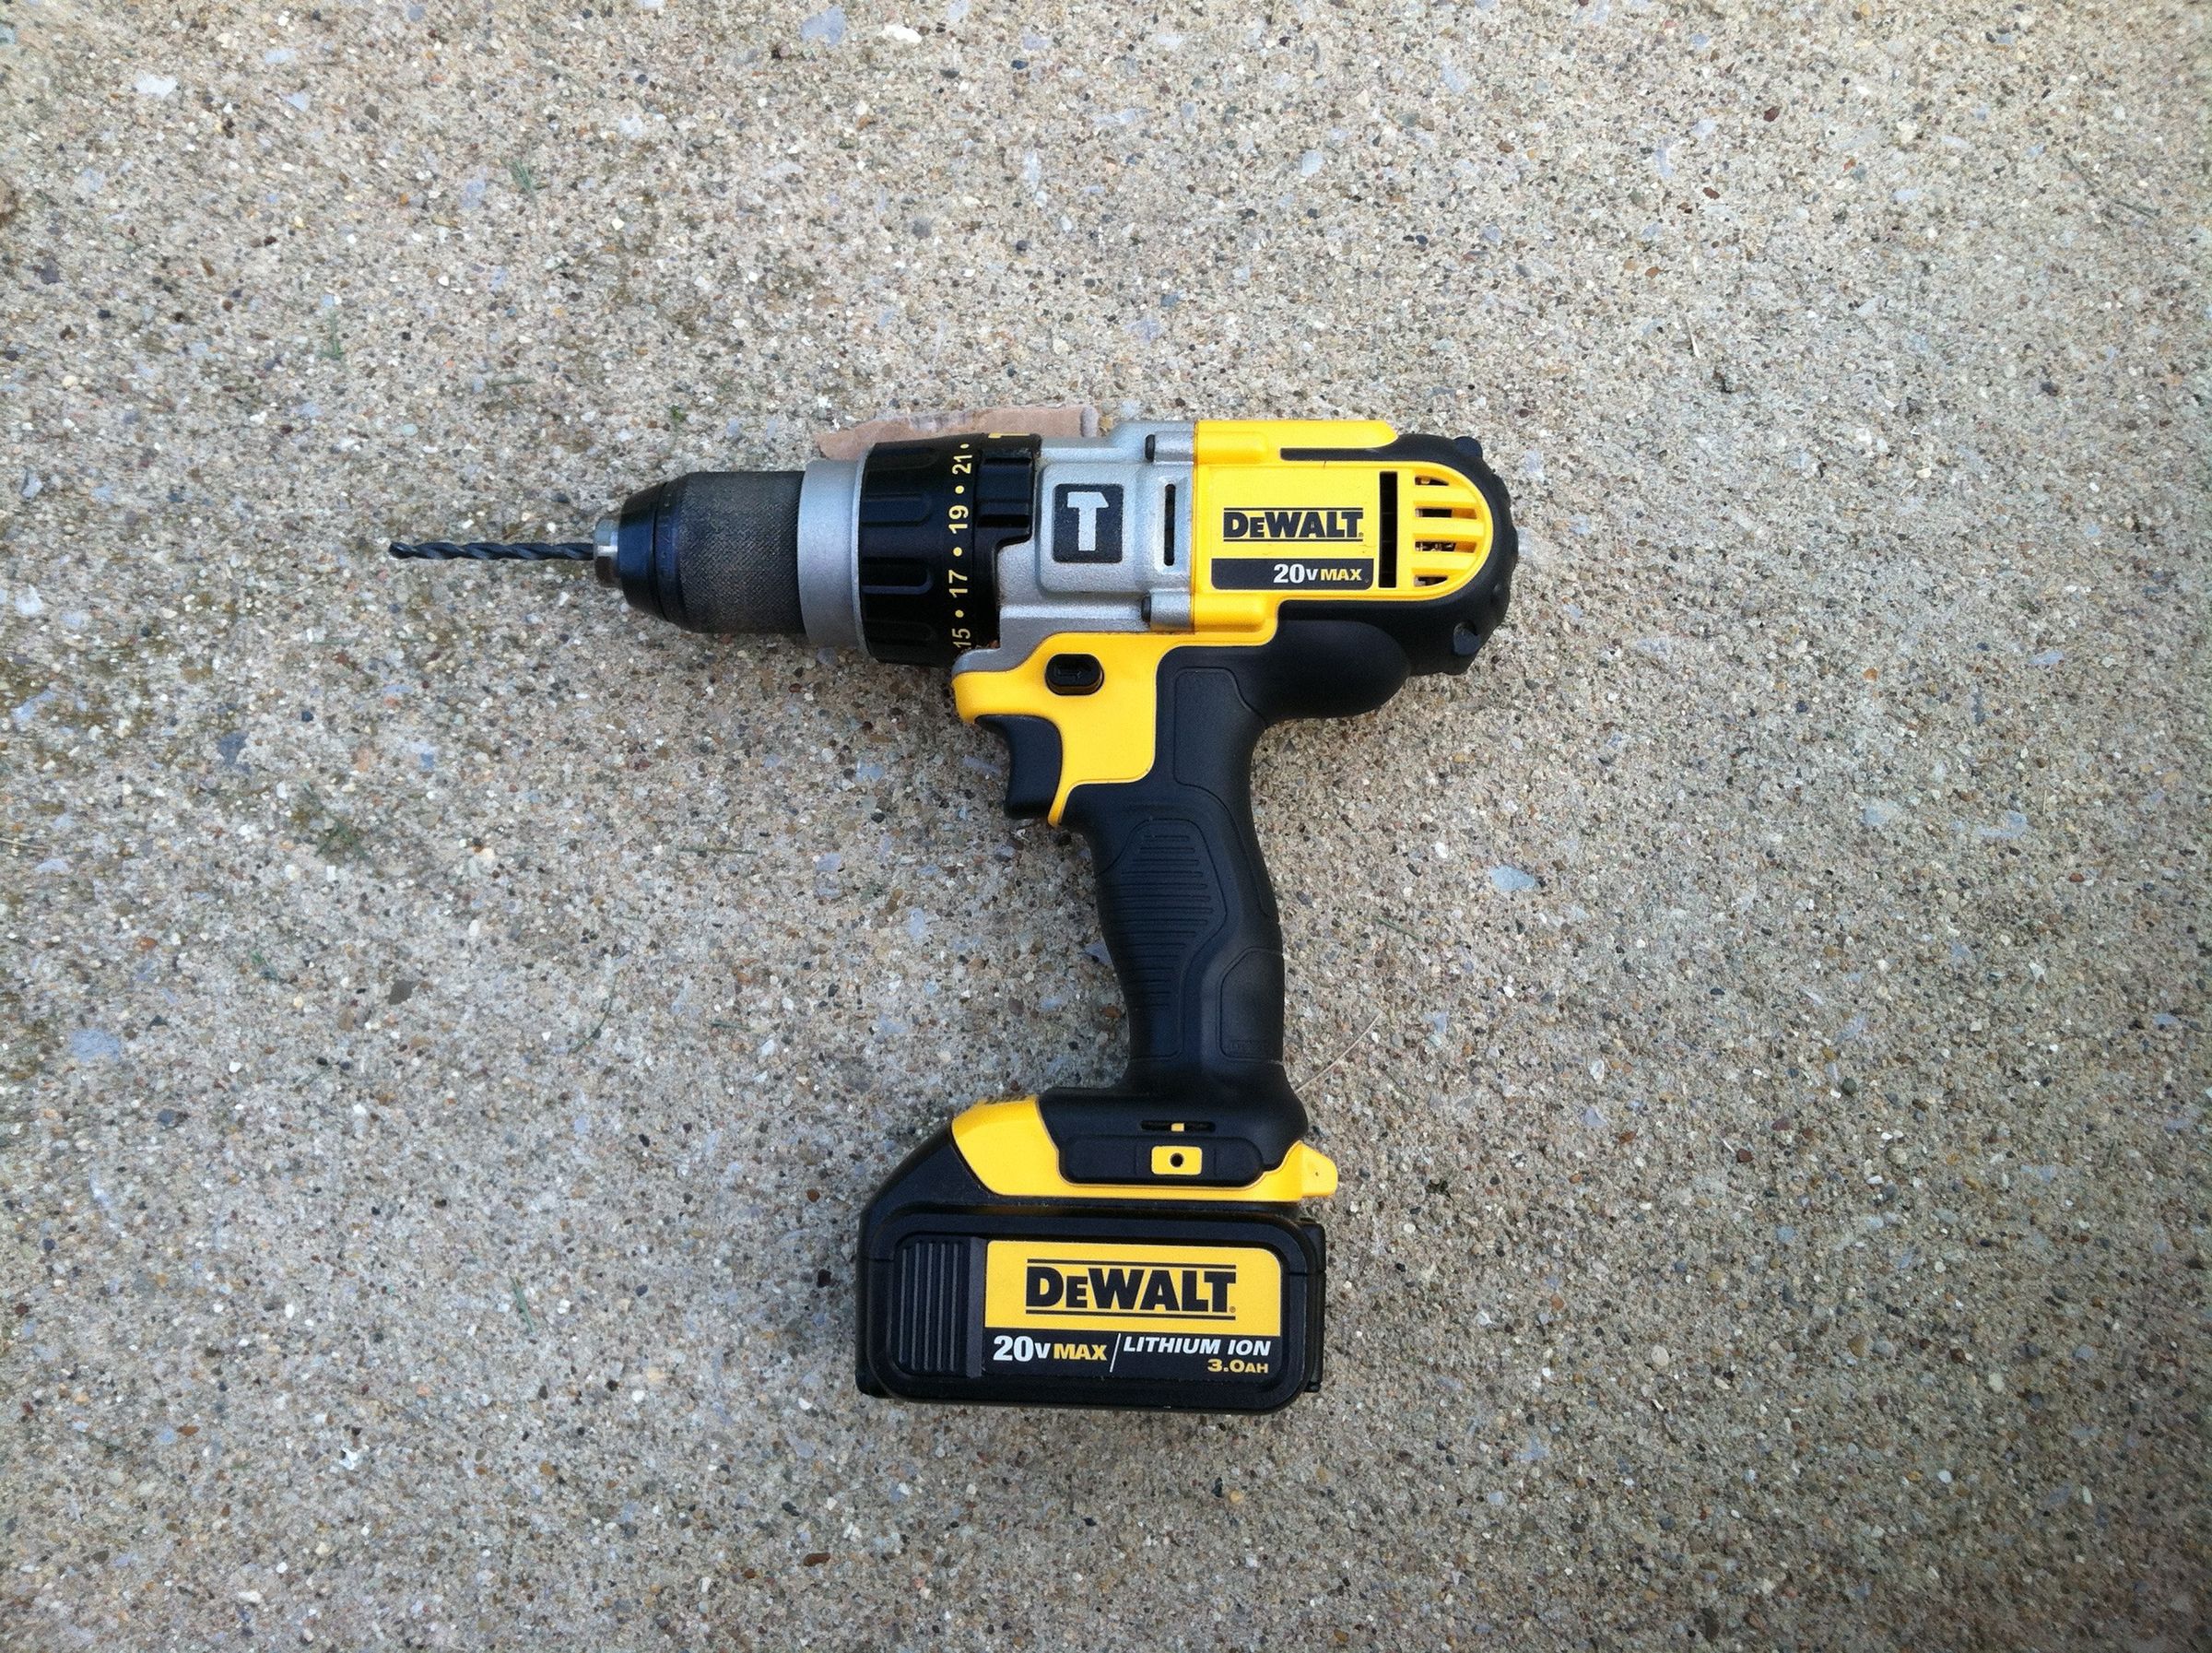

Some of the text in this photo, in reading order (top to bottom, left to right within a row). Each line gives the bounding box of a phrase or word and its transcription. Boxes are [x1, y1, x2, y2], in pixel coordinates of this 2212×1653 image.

[1223, 511, 1364, 538] DEWALT
[948, 455, 972, 648] 15 17 19 21
[1273, 563, 1362, 584] 20V MAX
[1025, 1266, 1237, 1313] DEWALT
[993, 1335, 1271, 1363] 20V MAX LITHIUM ION
[1207, 1358, 1269, 1374] 3.0AH
